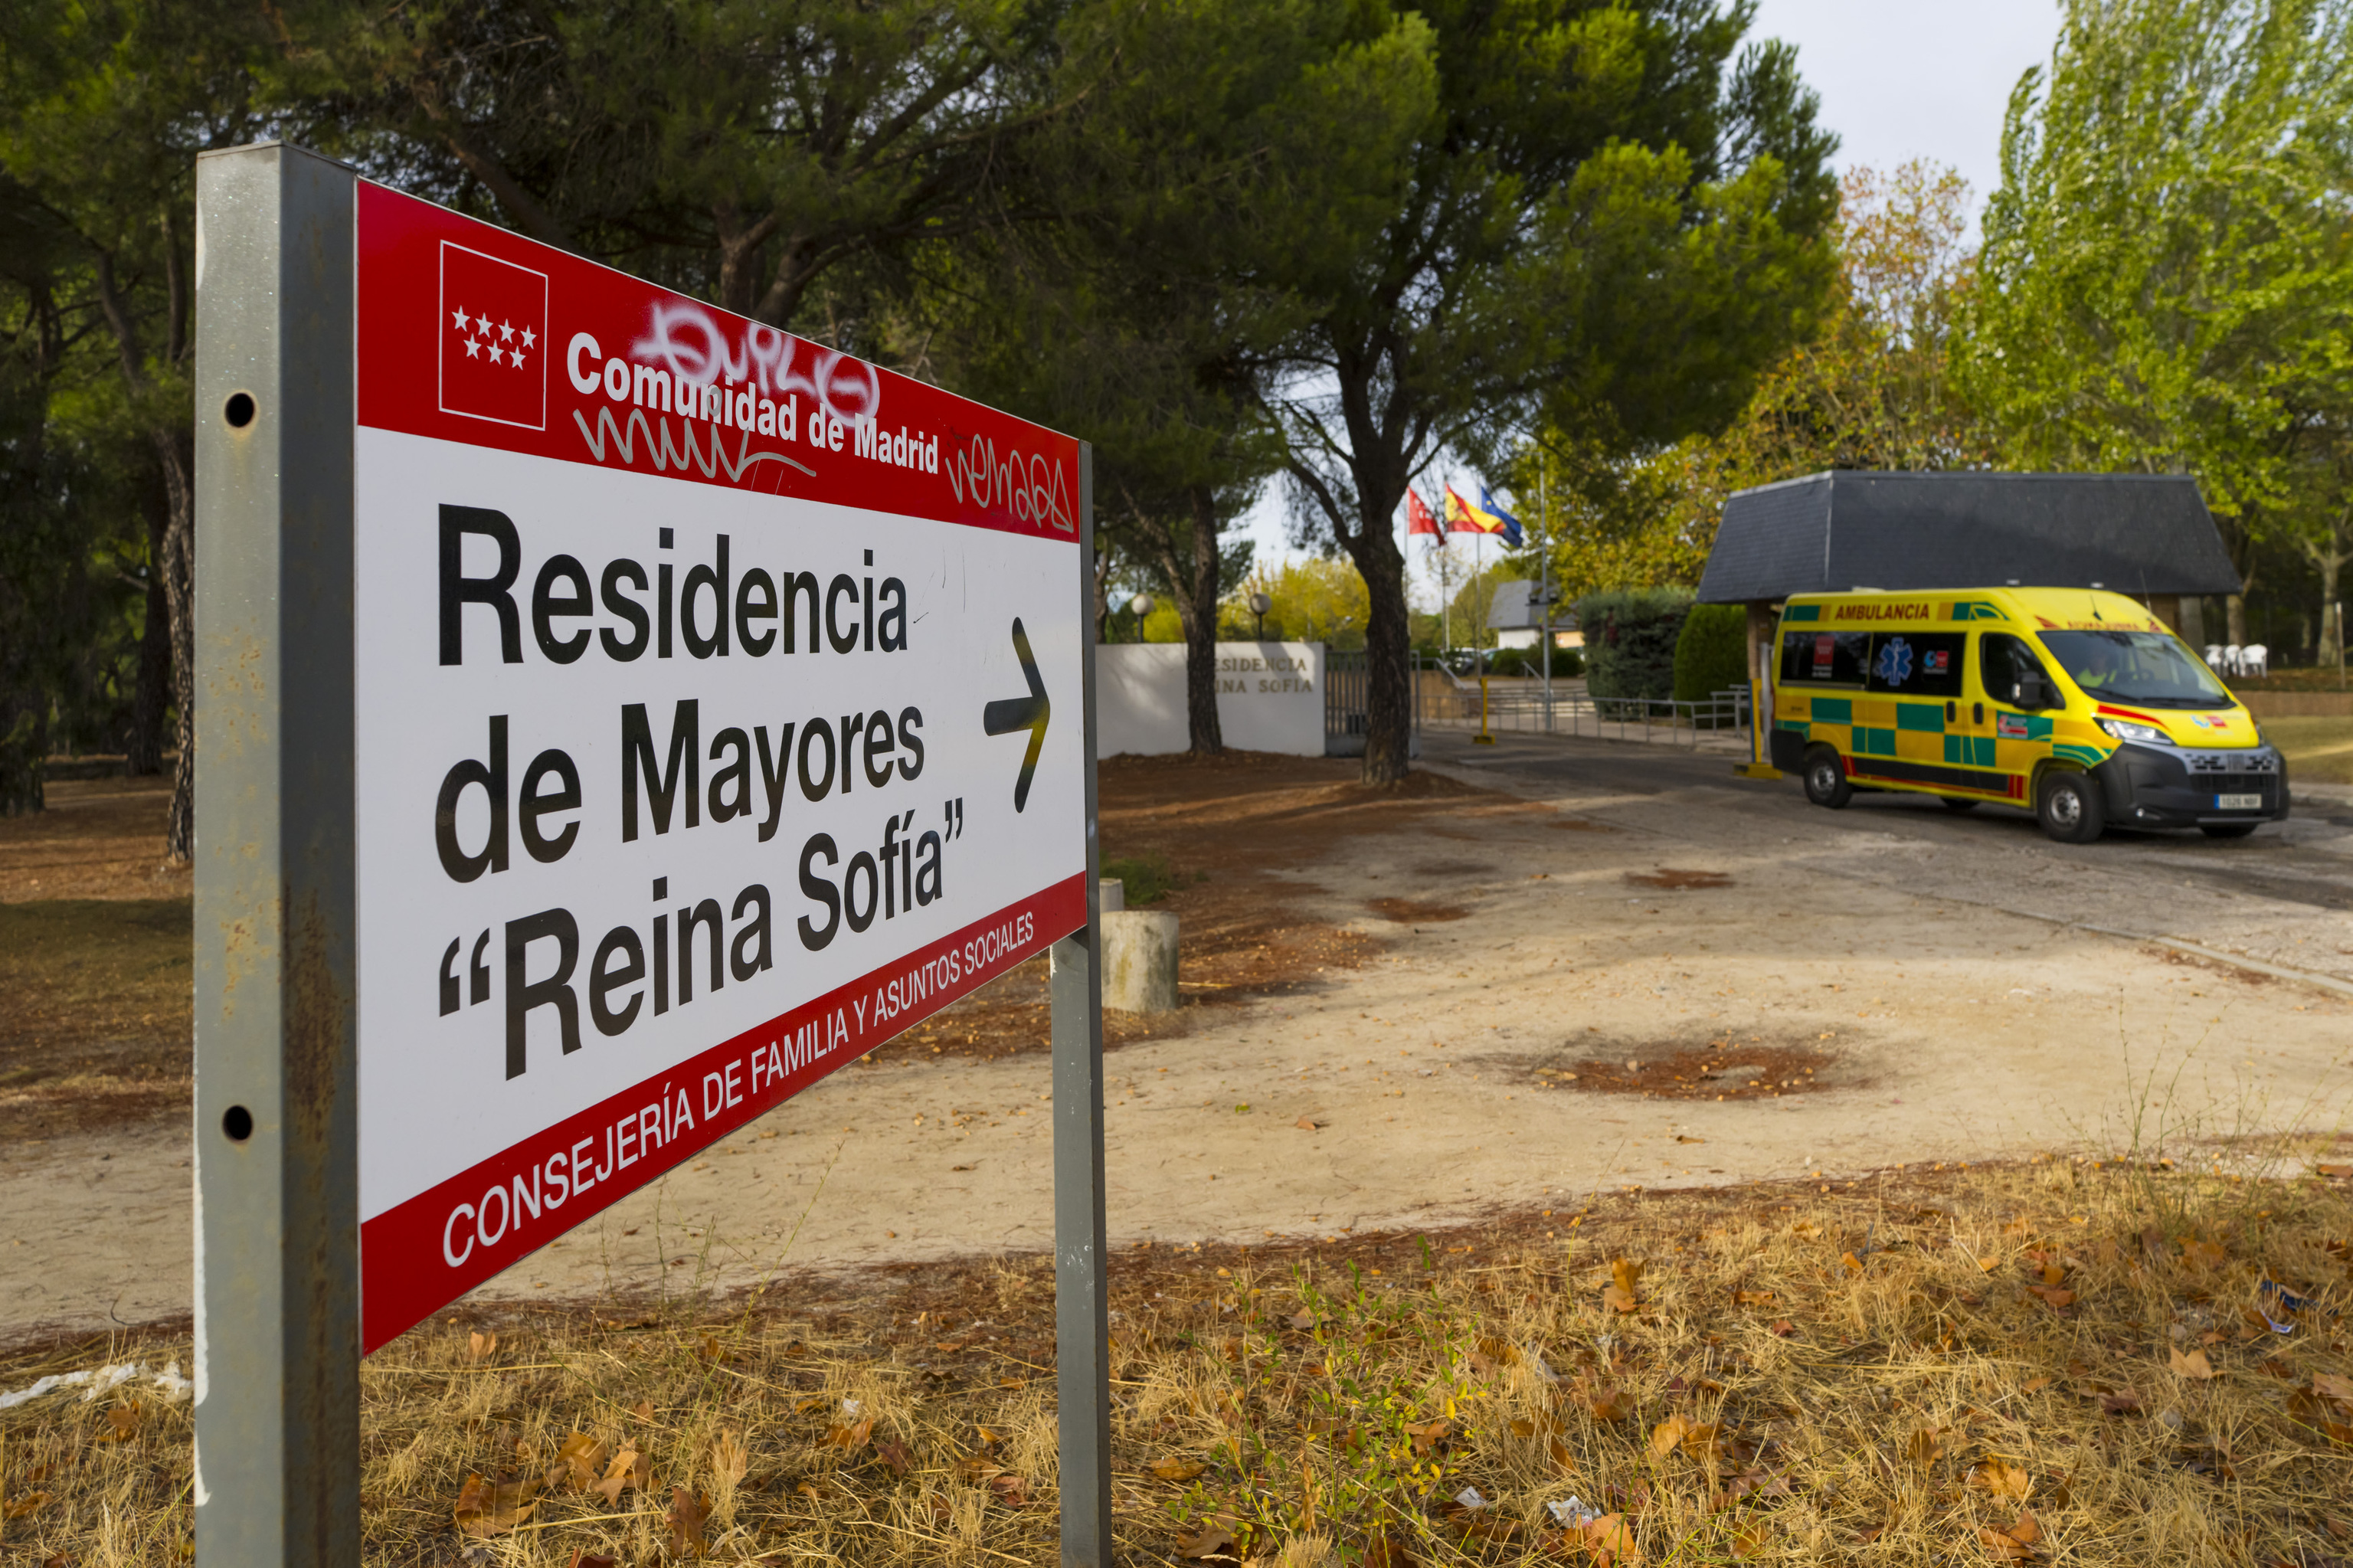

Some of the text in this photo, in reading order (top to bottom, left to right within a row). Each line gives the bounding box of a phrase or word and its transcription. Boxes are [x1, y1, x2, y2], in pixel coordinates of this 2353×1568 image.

[567, 332, 797, 442] Comunidad
[809, 402, 844, 452] de
[854, 413, 938, 474] Madrid
[439, 503, 908, 666] Residencia
[1835, 603, 1929, 620] AMBULANCIA
[1215, 679, 1314, 693] INA SOFIA
[435, 699, 925, 883] de Mayores
[439, 797, 964, 1082] “Reina Sofía”
[442, 911, 1034, 1267] CONSEJERÍA DE FAMILIA Y ASUNTOS SOCIALES
